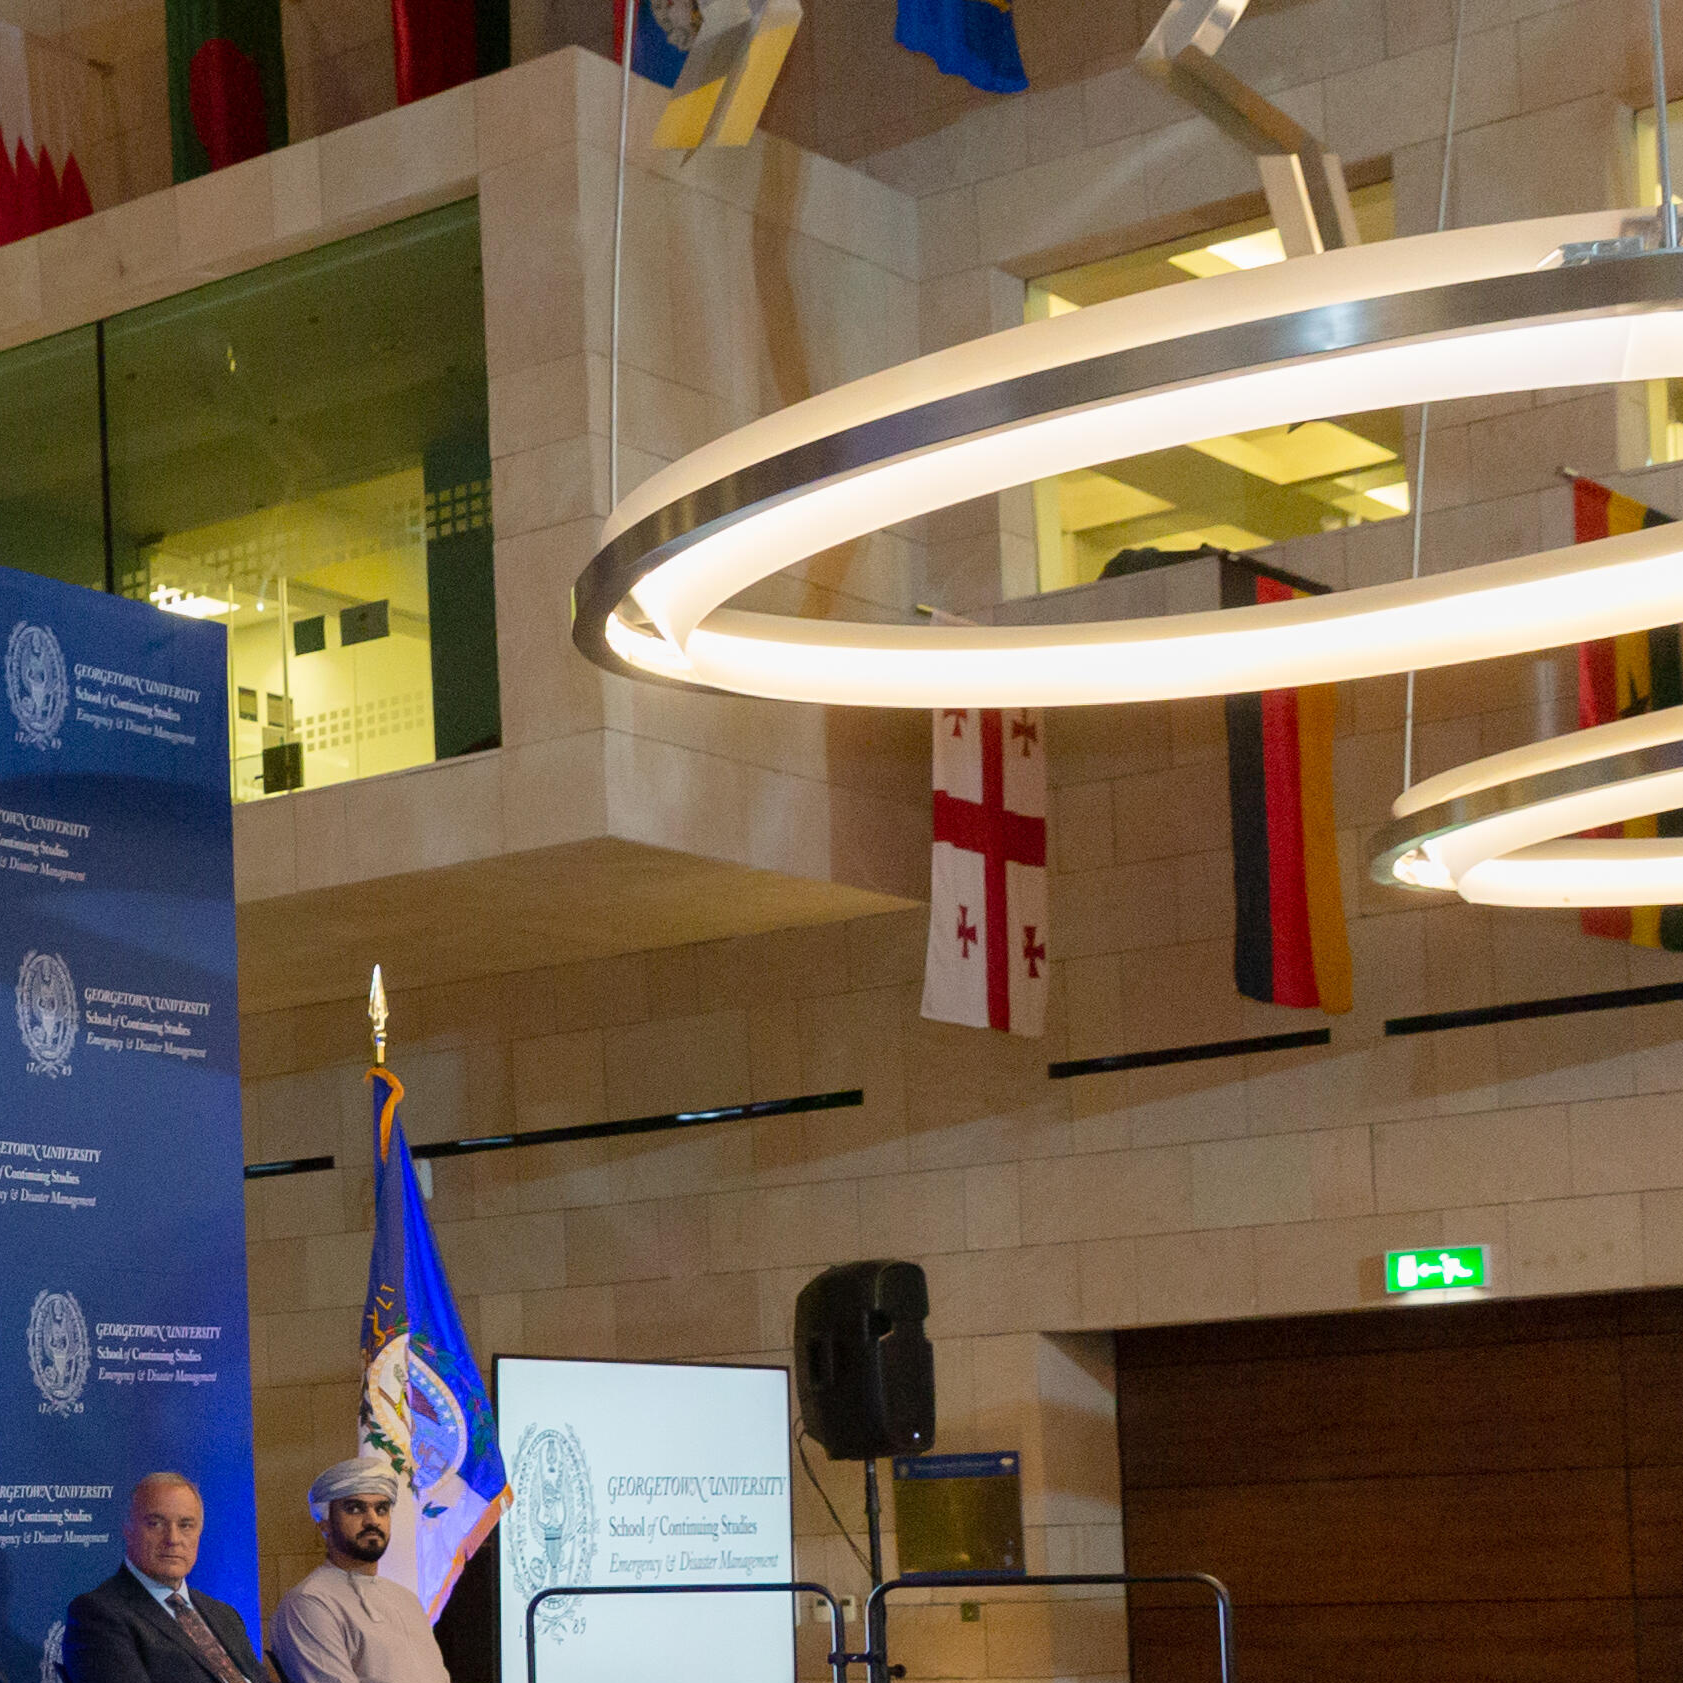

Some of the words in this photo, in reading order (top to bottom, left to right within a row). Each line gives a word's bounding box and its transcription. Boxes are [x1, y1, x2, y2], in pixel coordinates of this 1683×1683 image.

[607, 1476, 709, 1504] GEORGETOWN
[709, 1476, 786, 1496] UNIVERSITY
[608, 1516, 645, 1537] School
[647, 1516, 658, 1543] of
[660, 1516, 719, 1541] Continuing
[721, 1514, 758, 1535] Studies
[609, 1552, 662, 1580] Emergency
[666, 1554, 676, 1573] &
[679, 1551, 718, 1571] Disaster
[718, 1550, 779, 1575] Management
